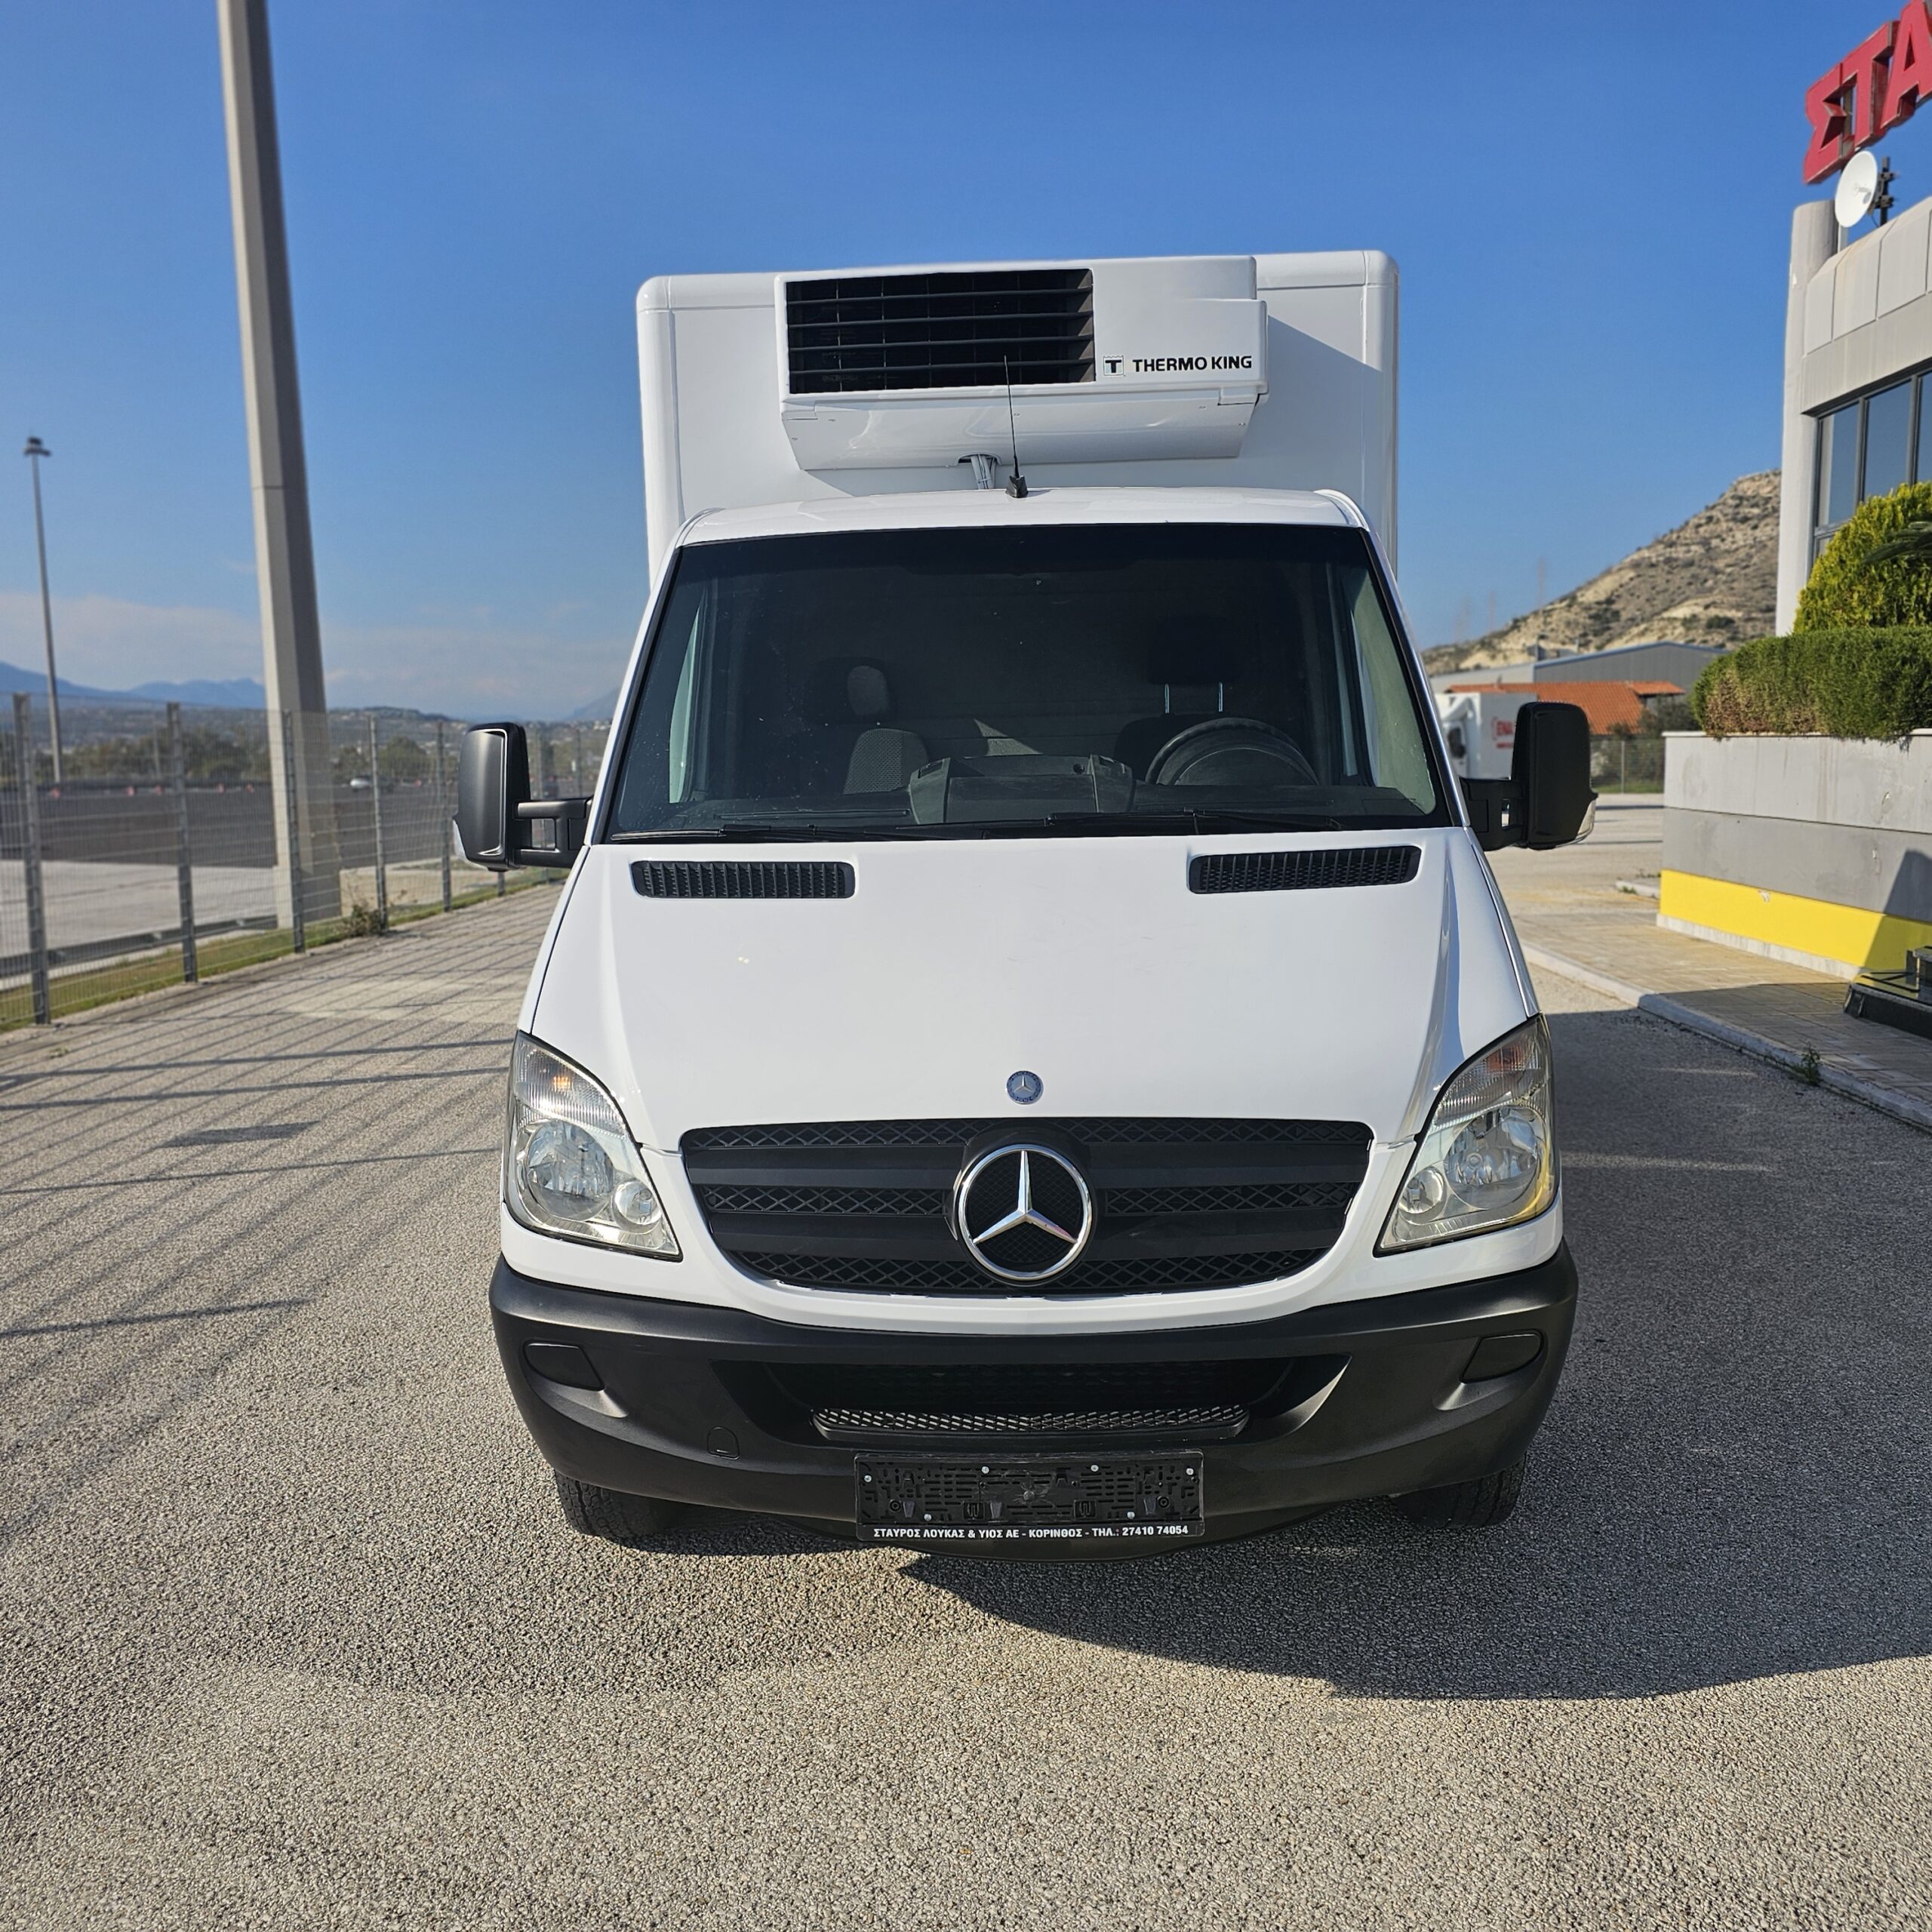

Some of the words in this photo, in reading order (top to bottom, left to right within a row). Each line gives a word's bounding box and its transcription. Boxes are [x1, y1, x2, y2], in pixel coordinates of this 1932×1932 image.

[1133, 356, 1208, 372] THERMO
[1211, 355, 1252, 370] KING
[874, 1528, 921, 1538] ΣΤΑΥΡΟΣ
[923, 1529, 965, 1538] ΛΟΥΚΑΣ
[968, 1530, 976, 1538] &
[979, 1529, 1003, 1539] ΥΙΟΣ
[1005, 1530, 1020, 1538] ΑΕ
[1029, 1528, 1083, 1538] ΚΟΡΙΝΘΟΣ
[1121, 1527, 1154, 1537] 27410
[1156, 1525, 1189, 1535] 74054
